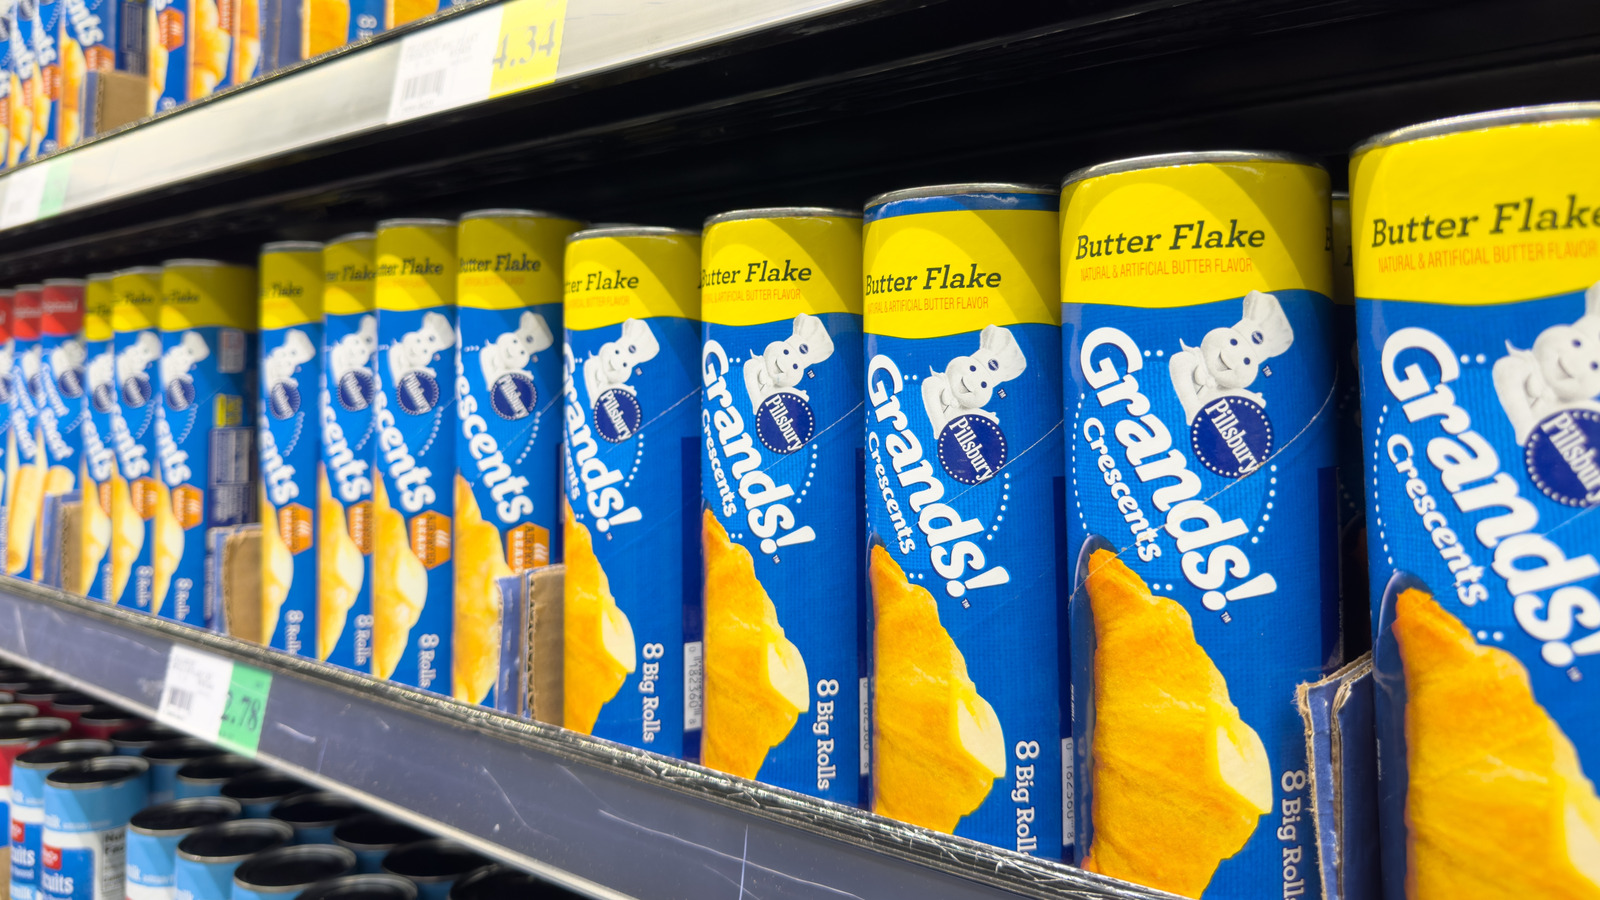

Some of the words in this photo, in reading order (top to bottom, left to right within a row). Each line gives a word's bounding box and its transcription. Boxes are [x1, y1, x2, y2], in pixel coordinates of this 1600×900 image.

[492, 20, 557, 69] 4.34
[1075, 234, 1162, 260] Butter
[1168, 219, 1266, 251] Flake
[1371, 213, 1479, 248] Butter
[494, 253, 541, 273] Flake
[744, 259, 812, 283] Flake
[1080, 264, 1111, 283] NATURAL
[1112, 264, 1119, 279] &
[1120, 259, 1170, 278] ARTIFICIAL
[1172, 258, 1212, 275] BUTTER
[1214, 257, 1253, 273] FLAVOR
[1378, 253, 1415, 274] NATURAL
[1418, 253, 1426, 270] &
[1428, 248, 1490, 269] ARTIFICIAL
[1493, 243, 1544, 264] BUTTER
[1547, 239, 1598, 260] FLAVOR
[585, 270, 640, 291] Flake
[773, 288, 801, 301] FLAVOR
[865, 274, 918, 296] Butter
[922, 263, 1002, 290] Flake
[889, 298, 923, 313] ARTIFICIAL
[924, 297, 955, 311] BUTTER
[956, 296, 989, 310] FLAVOR
[455, 335, 534, 524] escents
[601, 390, 633, 441] Pillsbury
[765, 394, 804, 452] Pillsbury
[702, 339, 816, 554] Grands!
[948, 416, 994, 482] Pillsbury
[1204, 398, 1260, 474] Pillsbury
[702, 408, 738, 518] Crescents
[867, 354, 1010, 598] Grands!
[1080, 326, 1278, 611] Grands!
[868, 431, 916, 555] Crescents
[1083, 417, 1162, 562] Crescents
[1387, 434, 1489, 607] Crescents
[284, 609, 304, 623] 8
[354, 613, 374, 628] 8
[418, 633, 440, 649] 8
[642, 642, 665, 660] 8
[418, 649, 437, 689] Rolls
[638, 661, 660, 694] Big
[816, 678, 840, 697] 8
[642, 695, 661, 743] Rolls
[812, 700, 835, 736] Big
[816, 738, 837, 791] Rolls
[1015, 740, 1040, 760] 8
[1010, 764, 1035, 803] Big
[1281, 769, 1306, 792] 8
[1277, 797, 1302, 842] Big
[1282, 846, 1304, 900] Roll
